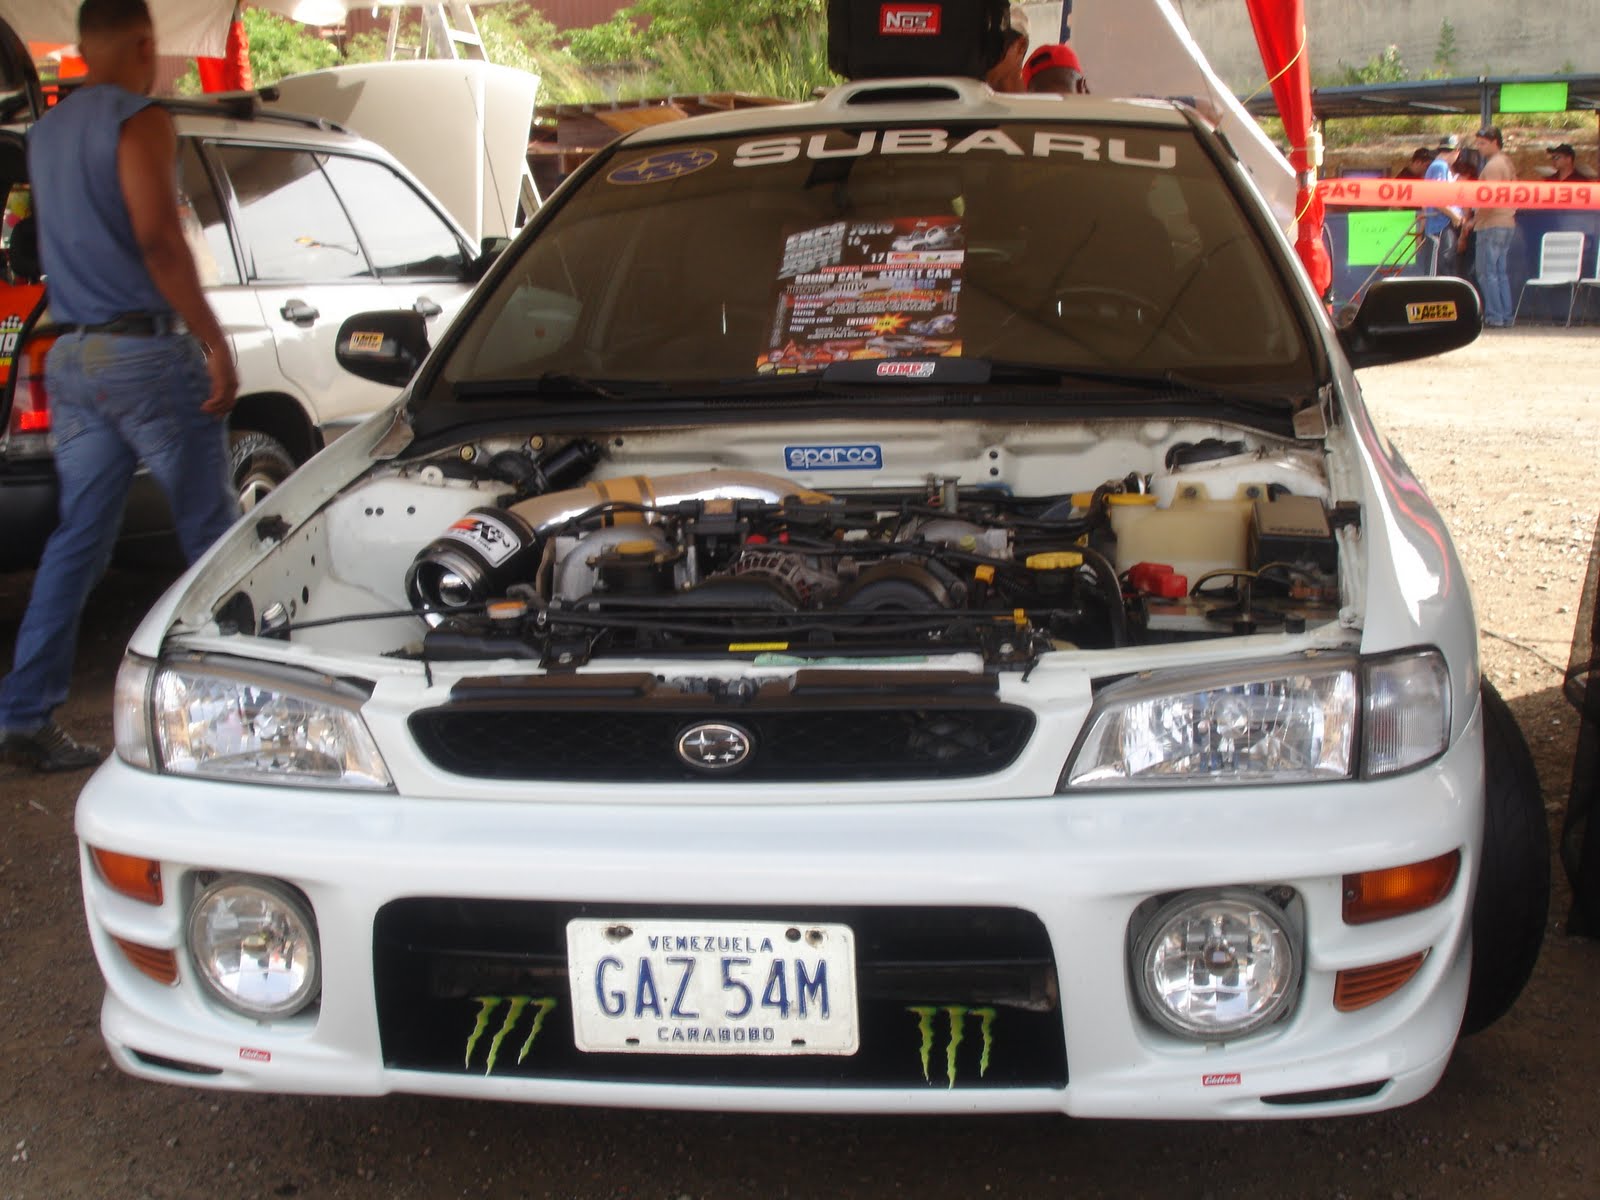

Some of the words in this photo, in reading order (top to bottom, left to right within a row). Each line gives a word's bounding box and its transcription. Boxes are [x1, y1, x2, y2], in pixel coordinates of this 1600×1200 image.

[886, 10, 928, 28] NOS
[732, 128, 1178, 169] SUBARU
[849, 223, 895, 236] JULIO
[871, 252, 885, 263] 17
[926, 269, 952, 279] CAR
[877, 362, 923, 376] COMP
[647, 935, 774, 953] VENEZUELA
[595, 955, 700, 1020] GAZ
[721, 957, 830, 1020] 54M
[656, 1026, 776, 1043] CARABOBO
